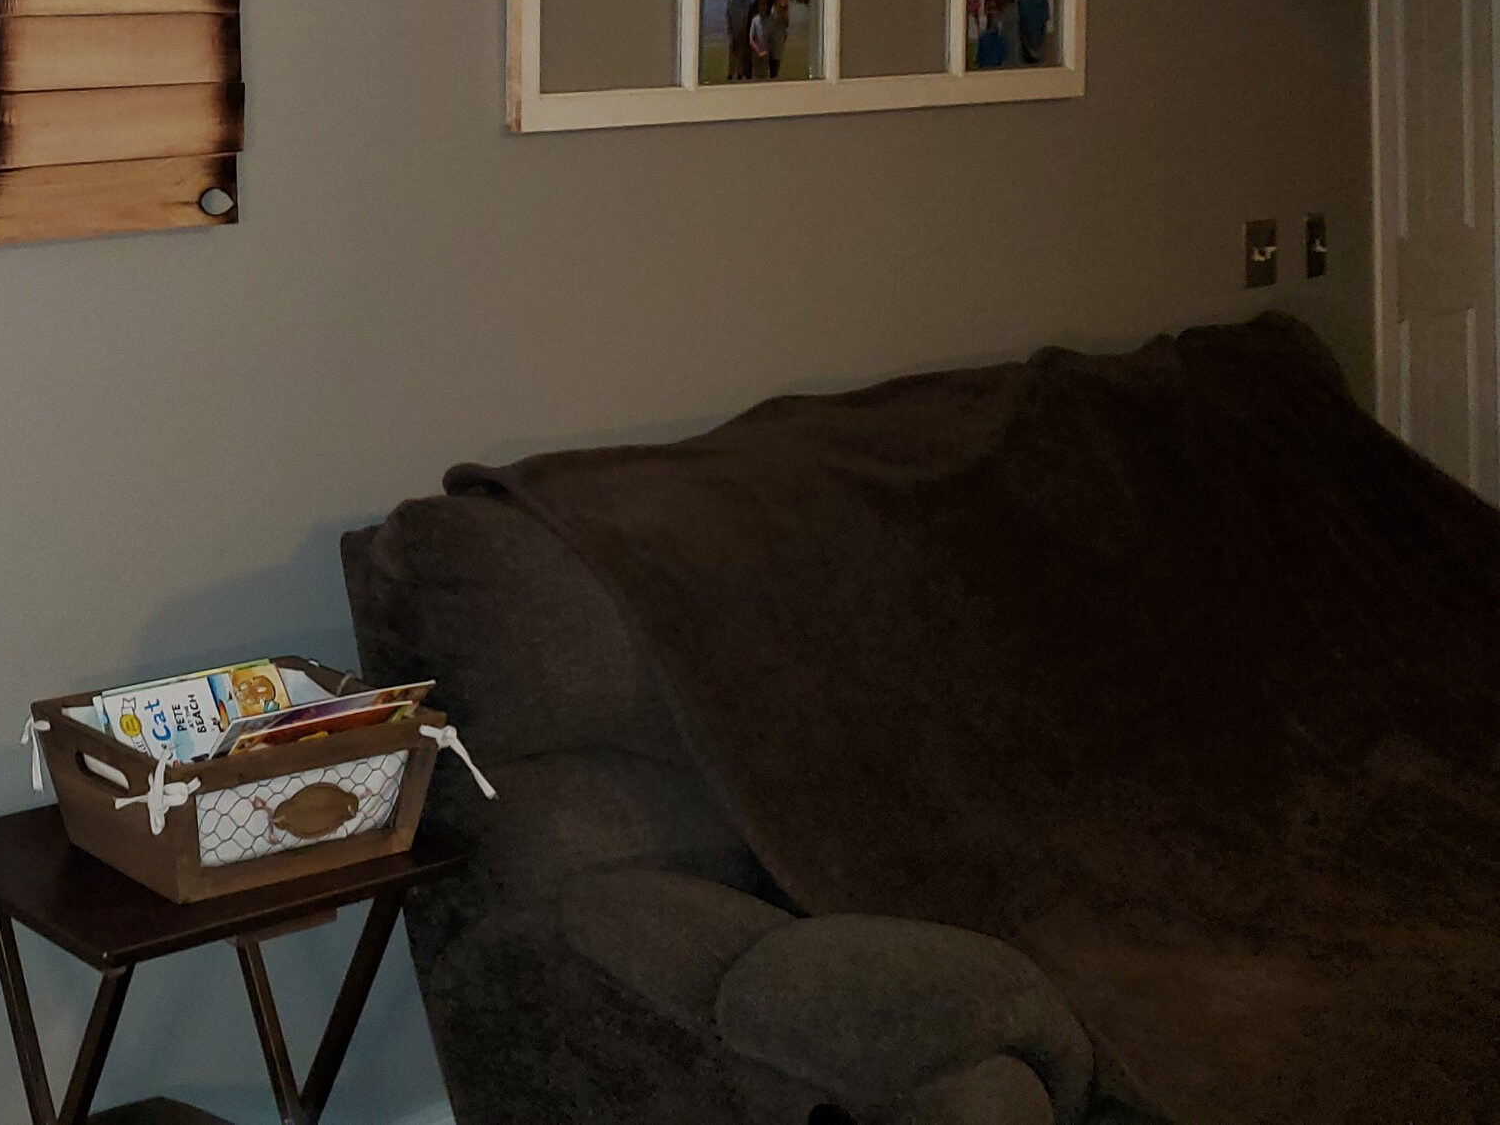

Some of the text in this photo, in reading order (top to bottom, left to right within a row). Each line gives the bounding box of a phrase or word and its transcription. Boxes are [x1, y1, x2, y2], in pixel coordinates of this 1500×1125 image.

[144, 699, 171, 741] Cat
[172, 703, 187, 732] PETE
[188, 694, 207, 733] BEACH
